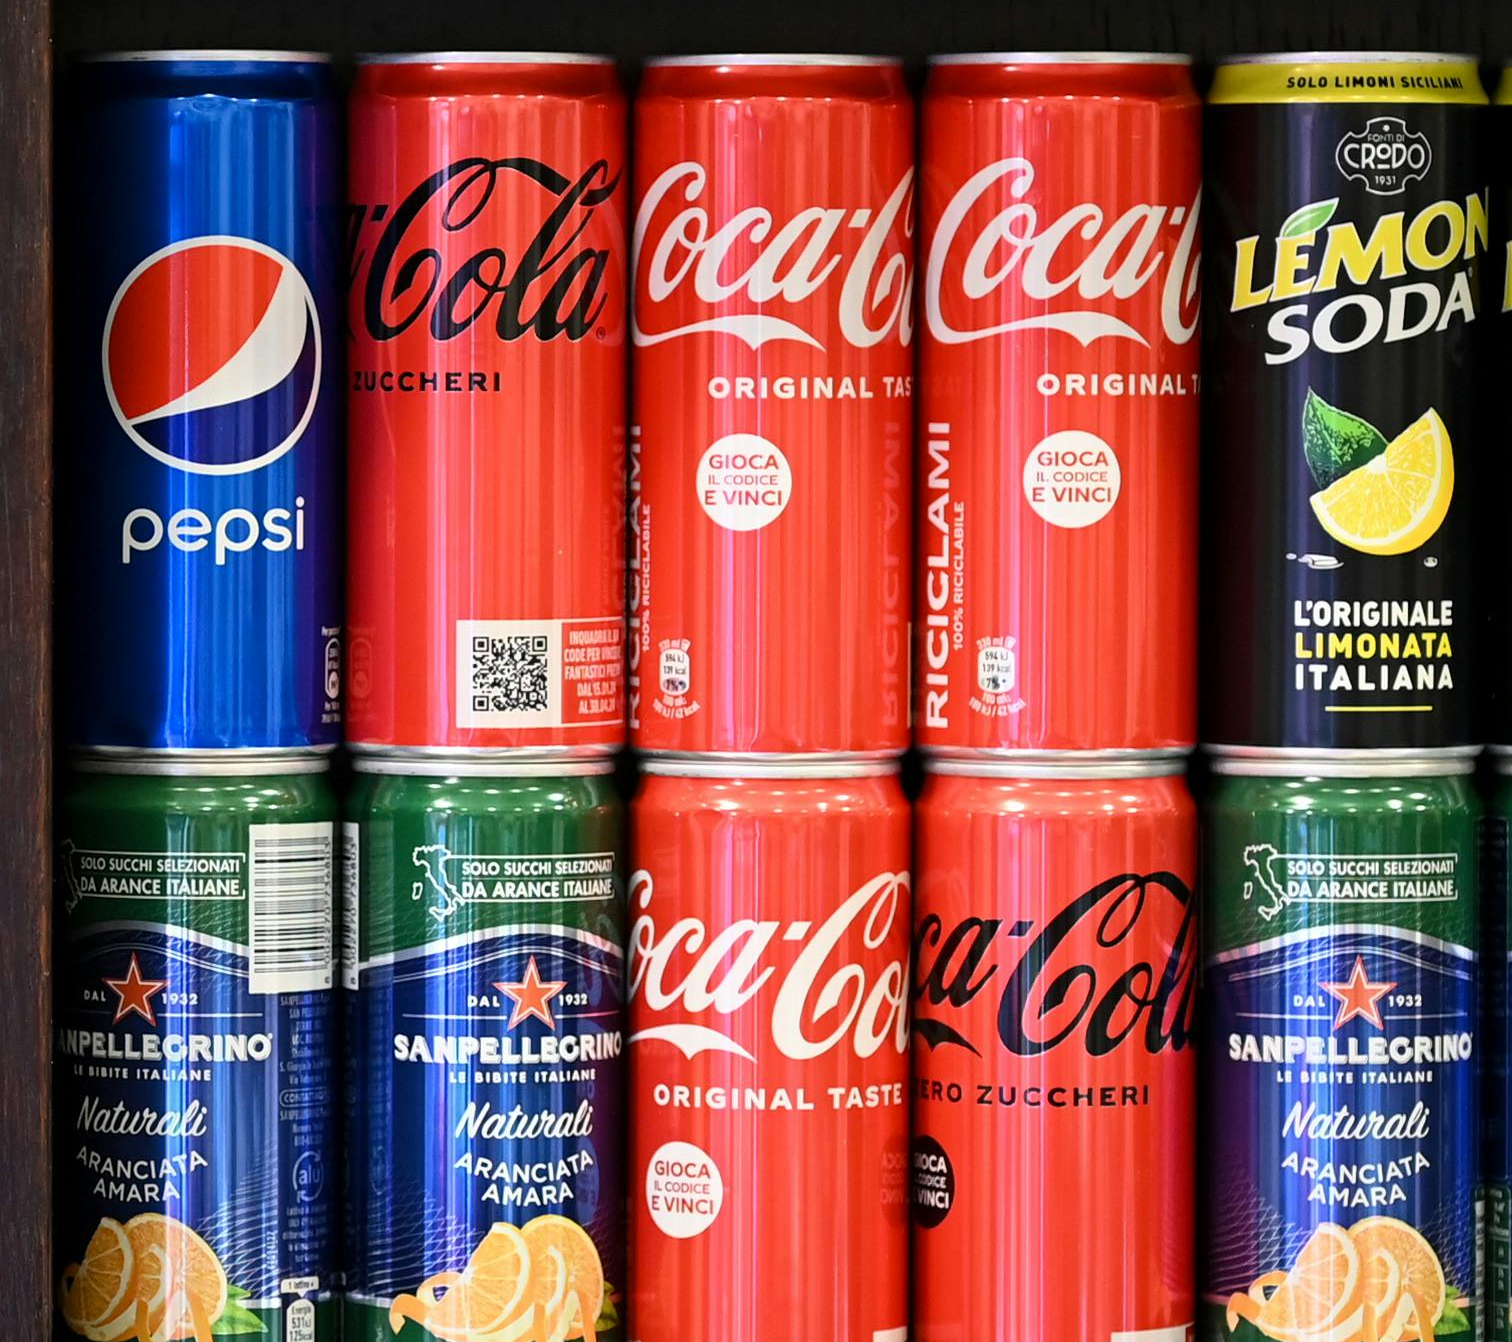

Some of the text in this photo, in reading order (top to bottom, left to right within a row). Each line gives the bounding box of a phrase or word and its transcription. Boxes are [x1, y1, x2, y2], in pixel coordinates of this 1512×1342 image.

[122, 496, 304, 565] pepsi
[1288, 861, 1454, 876] SOLO SUCCHI SELEZIONATI
[1287, 881, 1454, 898] DA ARANCE ITALIANE
[1293, 995, 1422, 1007] DAL 1932
[1229, 1035, 1471, 1063] SANPELLEGRINO
[1277, 1070, 1432, 1084] LE BIBITE ITALIANE
[652, 1085, 903, 1111] ORIGINAL TASTE
[977, 1085, 1150, 1107] ZUCCHERI
[1282, 1101, 1430, 1140] Naturali
[1282, 1152, 1430, 1184] ARANCIATA
[1307, 1184, 1406, 1207] AMARA
